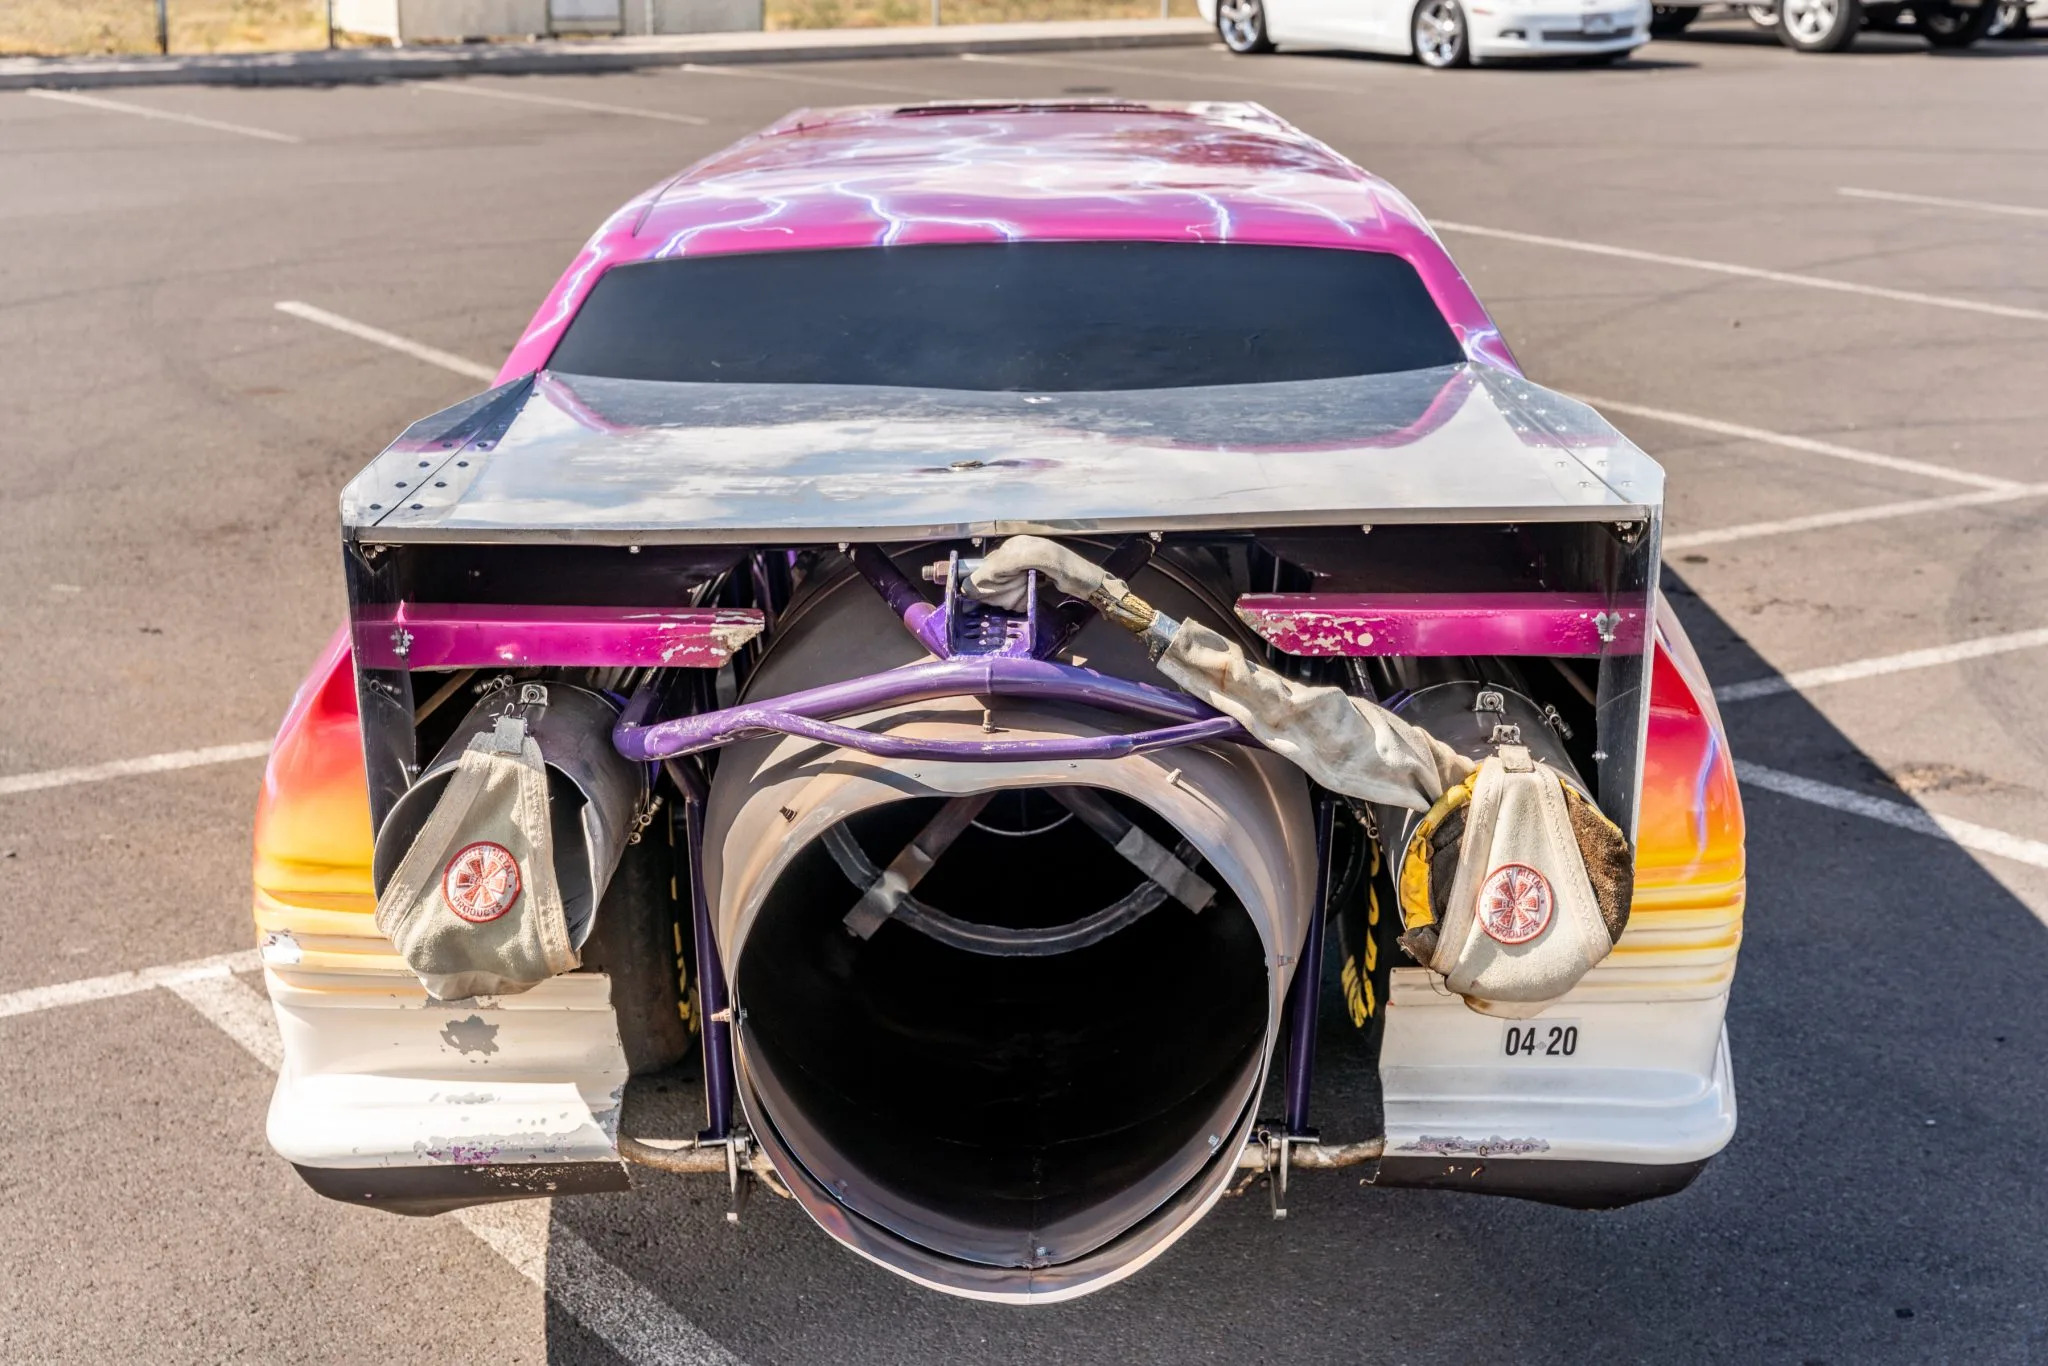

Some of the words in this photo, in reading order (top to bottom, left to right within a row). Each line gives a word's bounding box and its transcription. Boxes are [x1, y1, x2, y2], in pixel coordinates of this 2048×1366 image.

[452, 895, 503, 917] PRODUCTS
[1489, 920, 1541, 938] PRODUCTS
[1505, 1027, 1536, 1056] 04
[1546, 1026, 1578, 1056] 20
